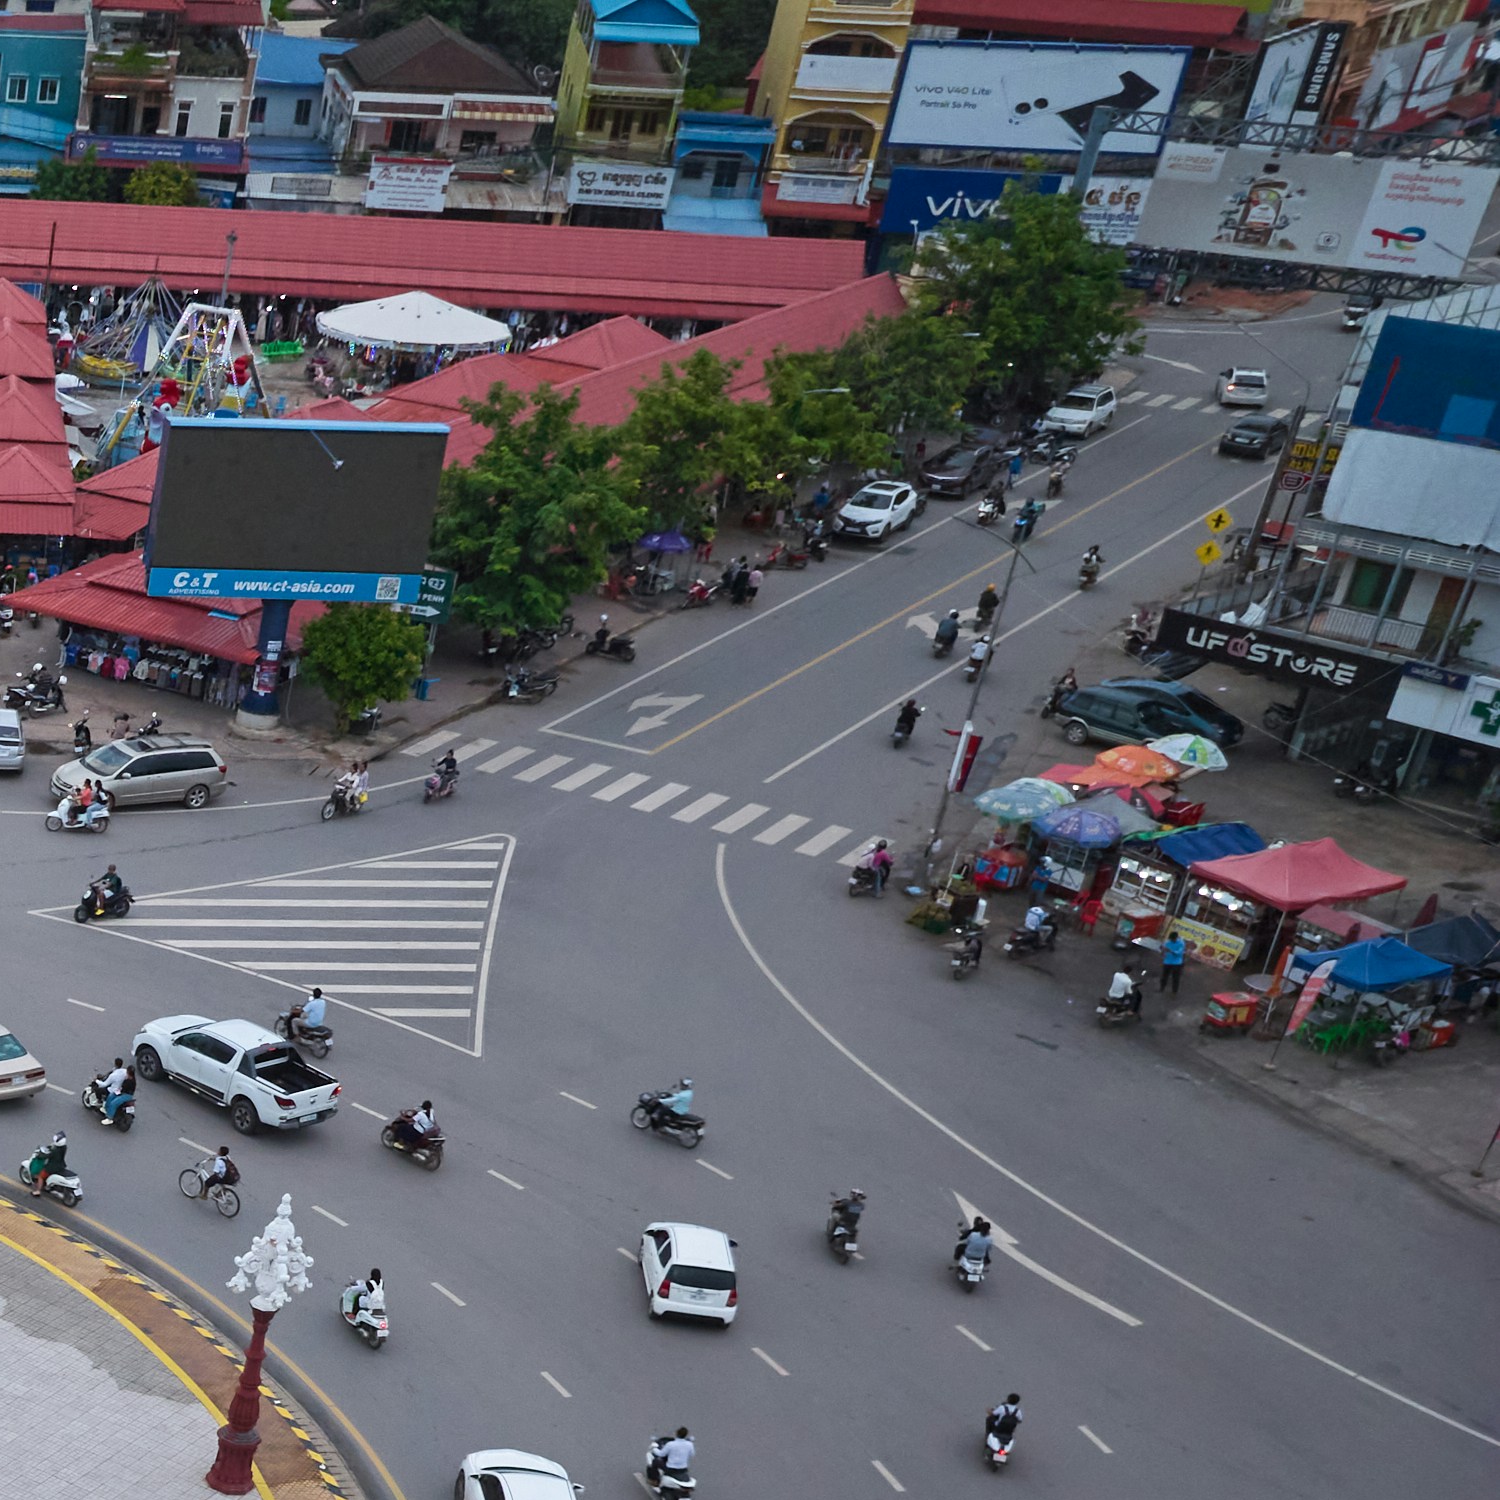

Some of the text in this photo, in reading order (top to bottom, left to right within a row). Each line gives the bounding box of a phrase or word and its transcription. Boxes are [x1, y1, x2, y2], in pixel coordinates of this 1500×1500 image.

[1305, 32, 1340, 103] SAMSUNG
[914, 84, 992, 96] vivo V40 Lite
[920, 100, 977, 110] Portrait So Pro
[168, 587, 220, 596] ADVERTISING
[233, 579, 355, 594] www.ct-asia.com
[422, 593, 445, 603] PENH
